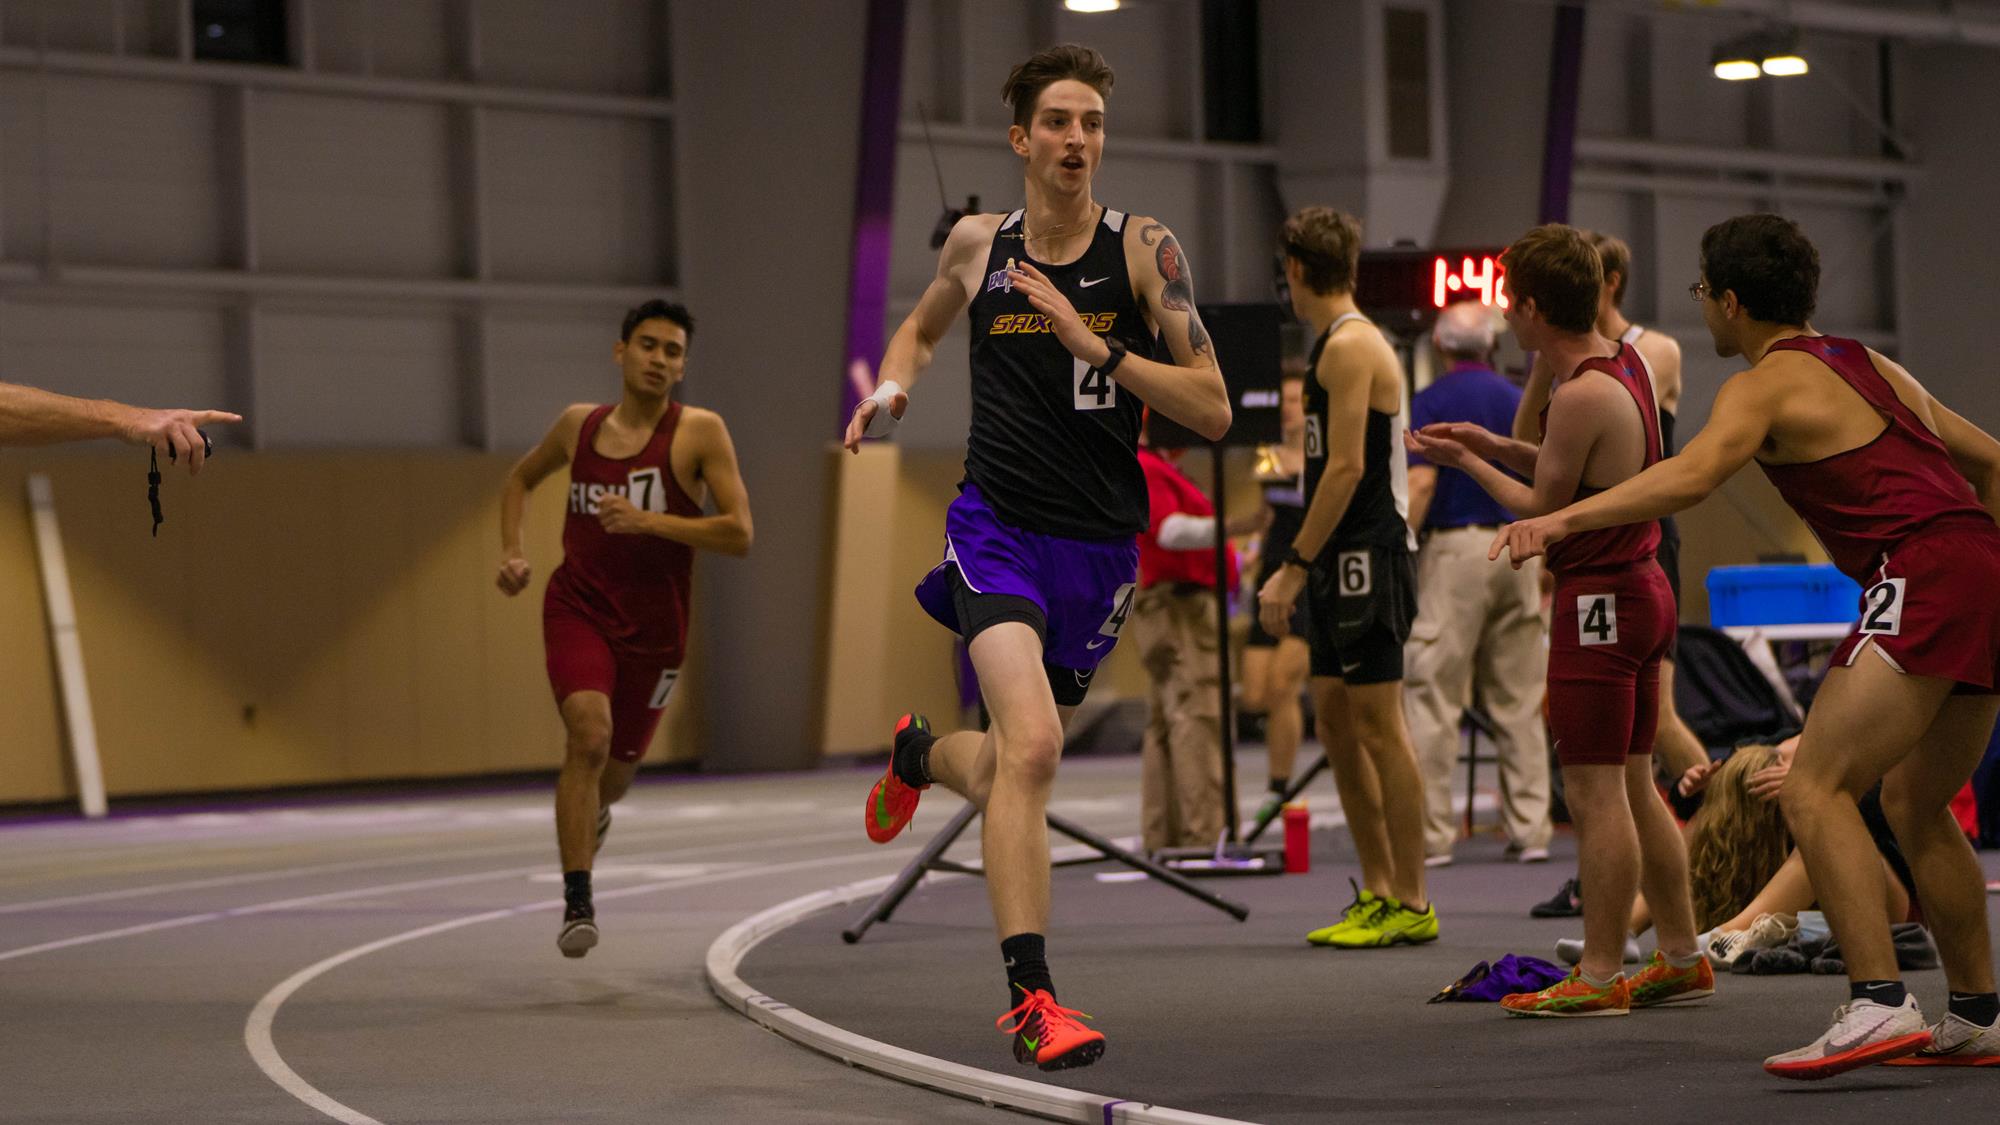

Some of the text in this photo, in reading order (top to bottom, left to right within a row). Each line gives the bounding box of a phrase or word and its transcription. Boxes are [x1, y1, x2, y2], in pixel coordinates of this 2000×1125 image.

[990, 312, 1117, 334] SAXS
[1079, 366, 1110, 405] 4
[632, 473, 654, 511] 7
[1344, 556, 1364, 592] 6
[1110, 587, 1135, 633] 4
[1583, 598, 1611, 641] 4
[1866, 582, 1896, 630] 2
[657, 673, 677, 705] 7
